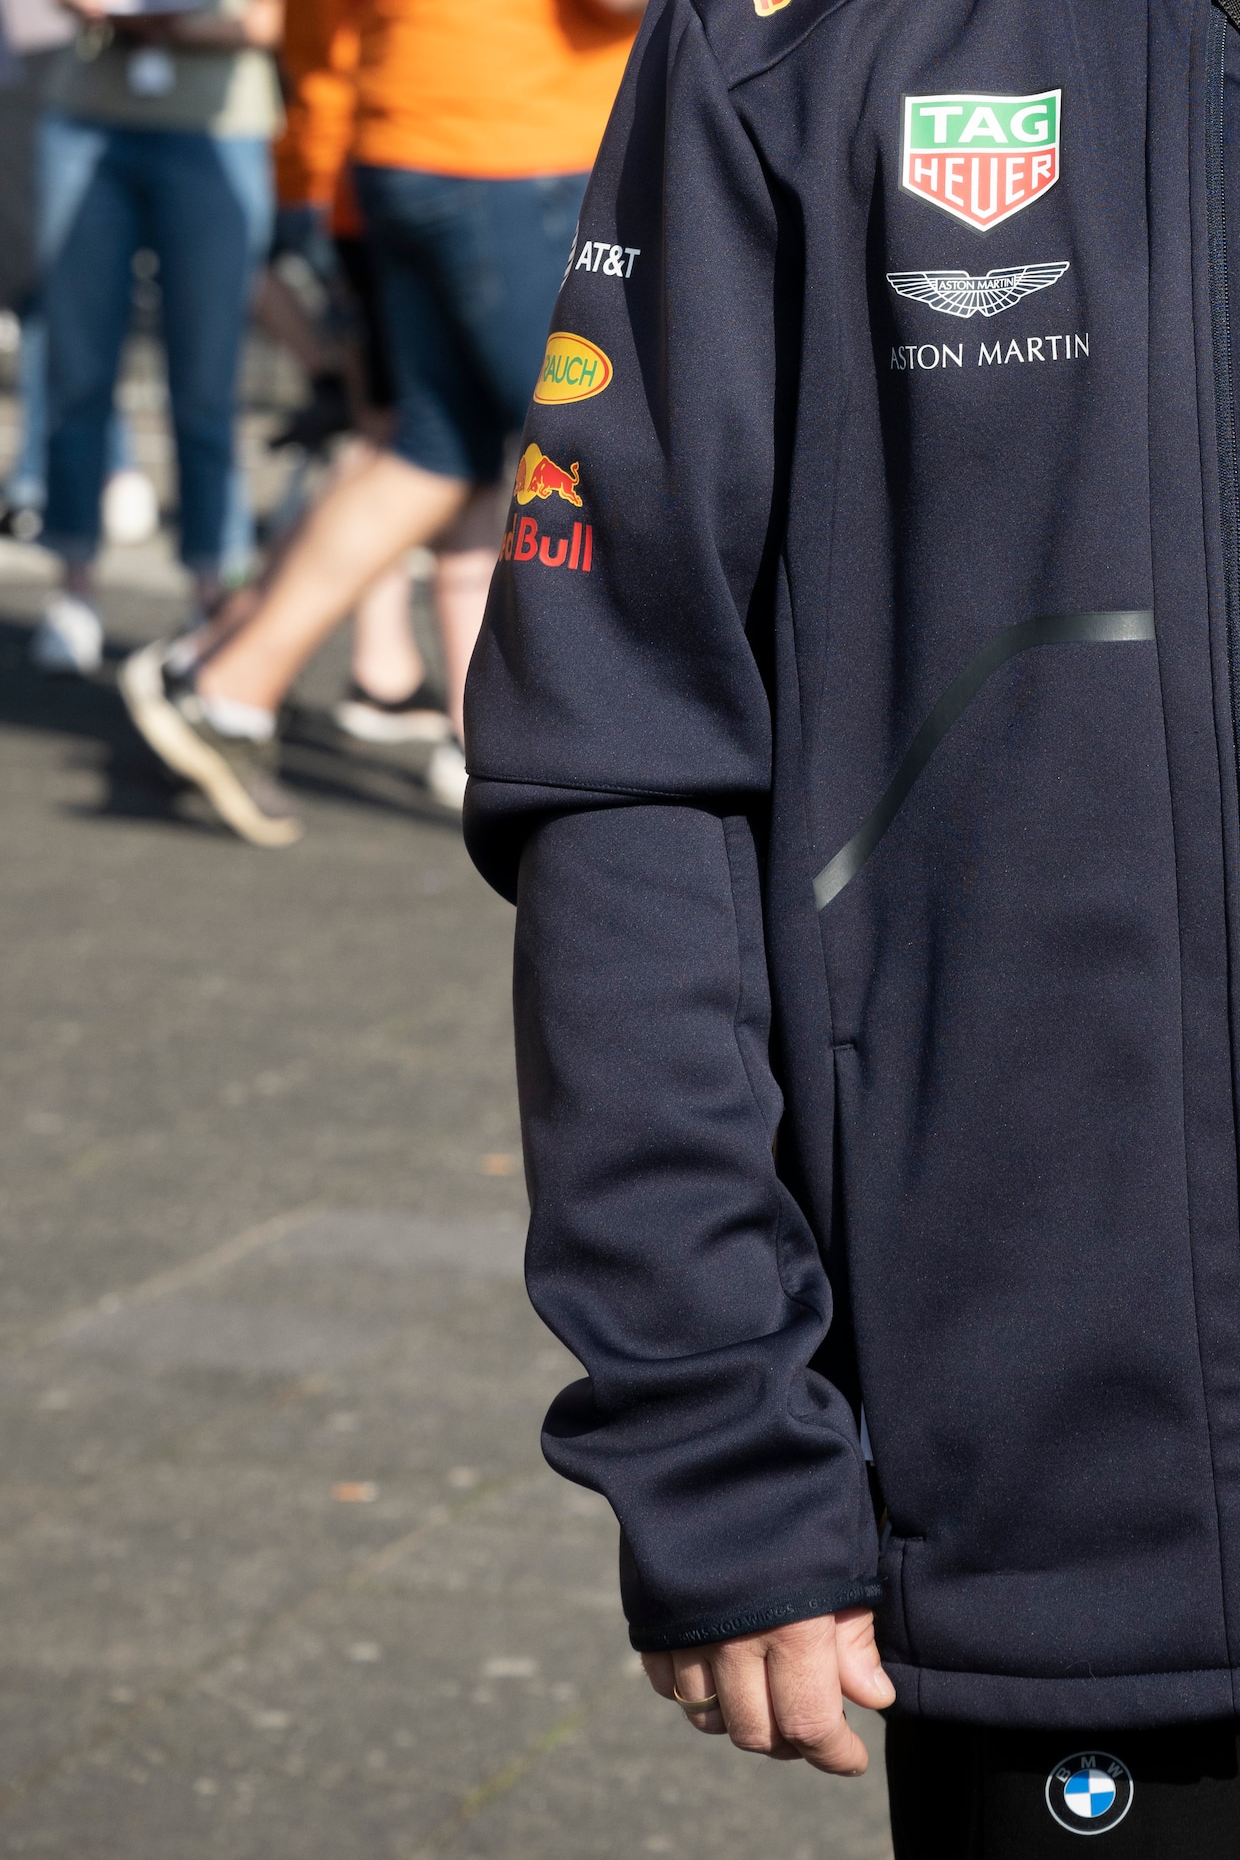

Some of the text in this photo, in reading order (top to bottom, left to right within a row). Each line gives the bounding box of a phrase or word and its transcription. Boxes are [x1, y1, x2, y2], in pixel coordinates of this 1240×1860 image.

[919, 104, 1048, 144] TAG
[914, 153, 1052, 219] HEUER
[575, 240, 642, 278] AT&T
[938, 276, 1014, 291] ASTON MARTIN
[890, 332, 1090, 371] ASTON MARTIN
[514, 517, 593, 572] Bull
[1055, 1755, 1124, 1784] BMW
